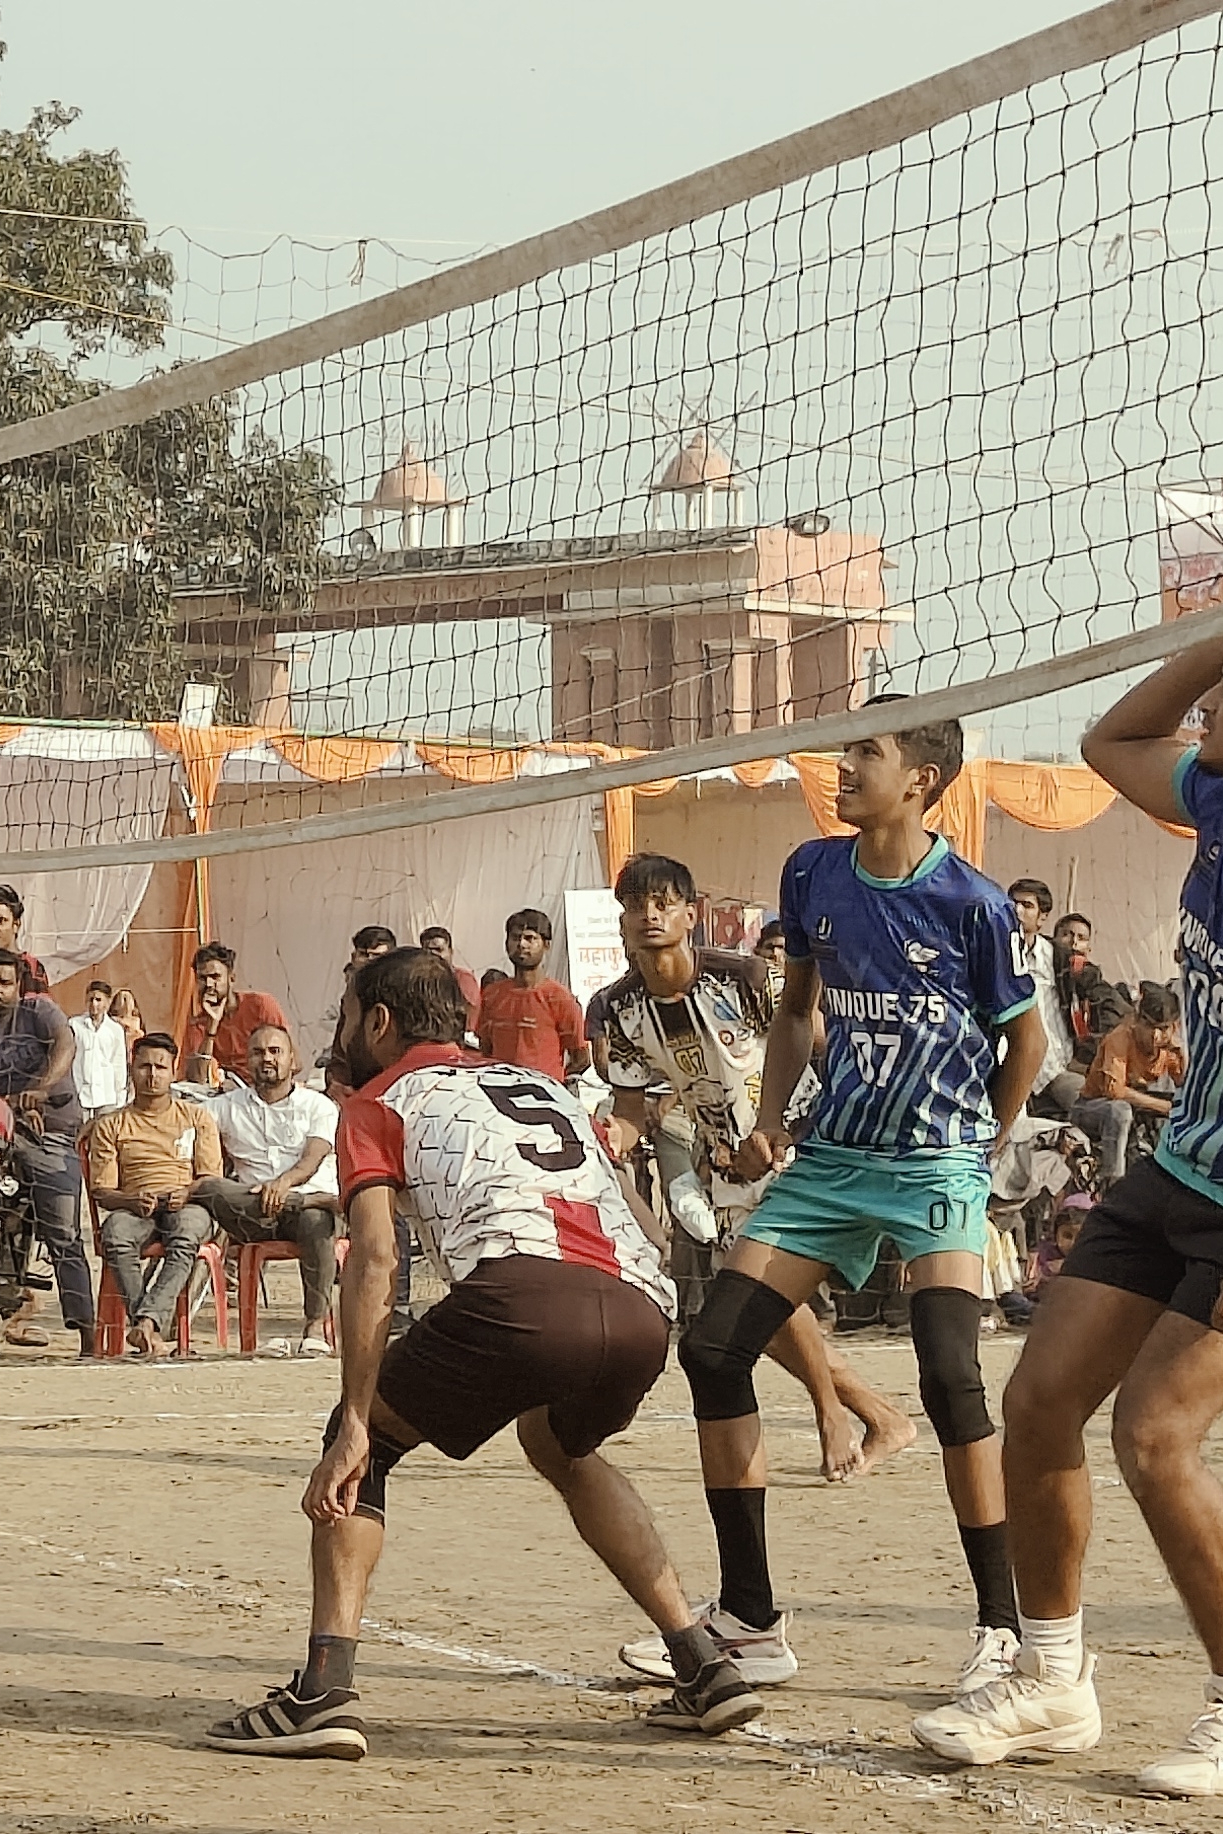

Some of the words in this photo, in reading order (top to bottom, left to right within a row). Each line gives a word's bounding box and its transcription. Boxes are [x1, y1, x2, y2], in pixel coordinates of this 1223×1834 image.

[827, 987, 899, 1022] NIQUE
[908, 993, 947, 1024] 75
[850, 1031, 902, 1088] 07
[478, 1083, 586, 1172] 5
[929, 1199, 967, 1230] 07
